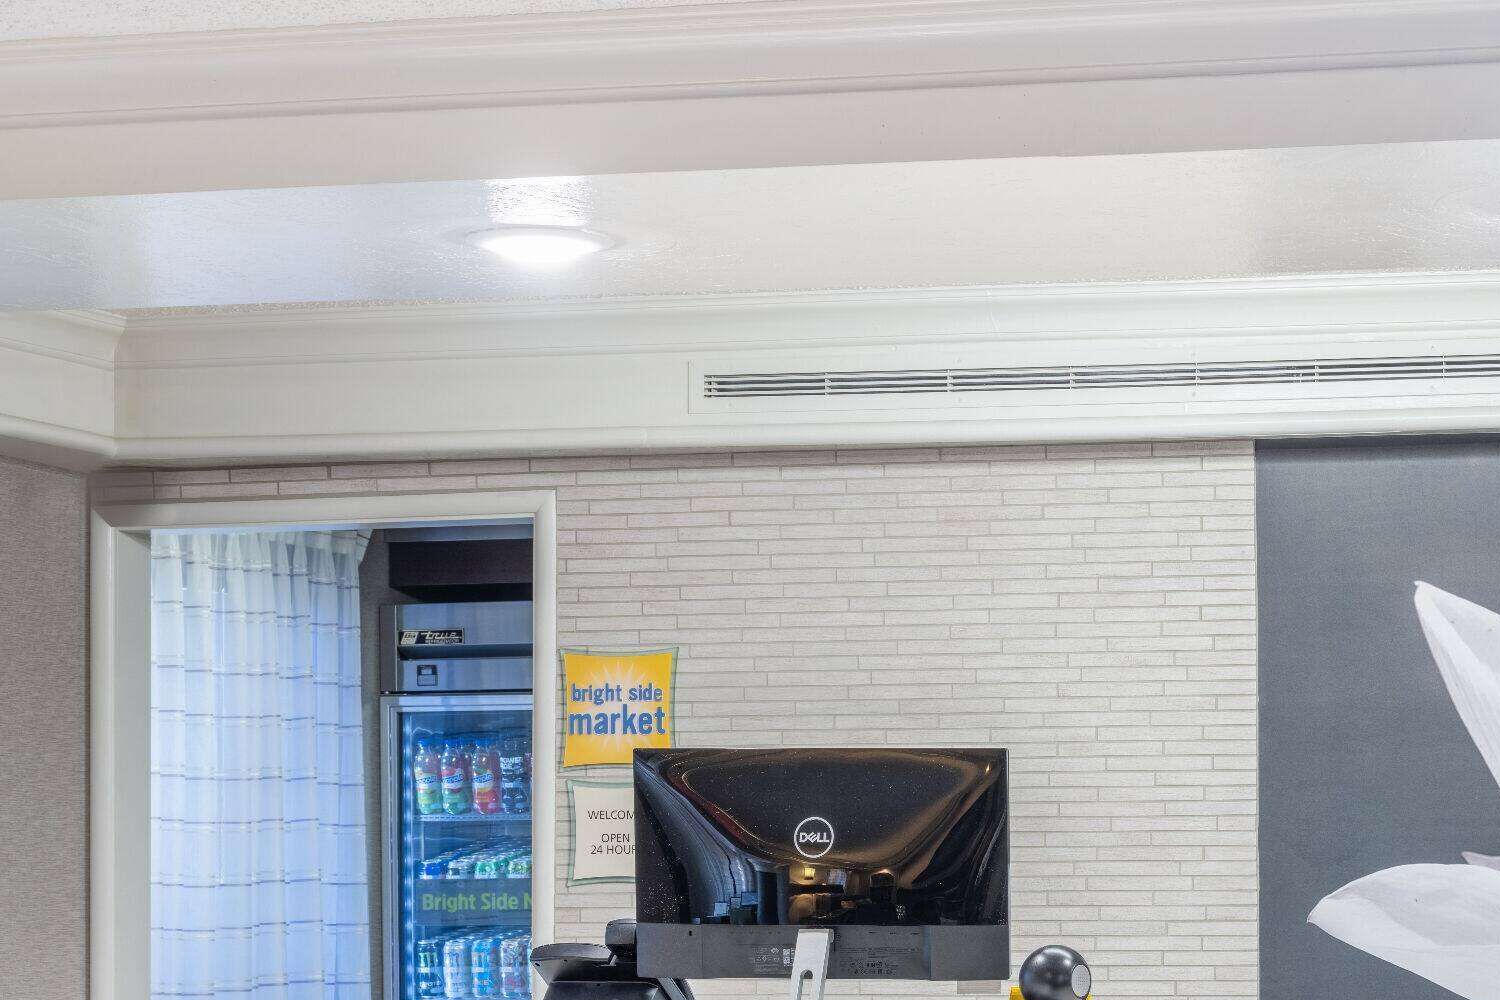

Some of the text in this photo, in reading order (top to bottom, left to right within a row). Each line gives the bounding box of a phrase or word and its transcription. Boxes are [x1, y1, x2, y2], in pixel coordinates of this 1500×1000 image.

[571, 682, 663, 705] bright side
[568, 704, 666, 735] market
[587, 810, 635, 820] WELCOM
[601, 833, 630, 843] OPEN
[799, 831, 830, 843] DELL
[590, 844, 603, 855] 24
[422, 892, 477, 913] Bright
[480, 892, 519, 910] Side
